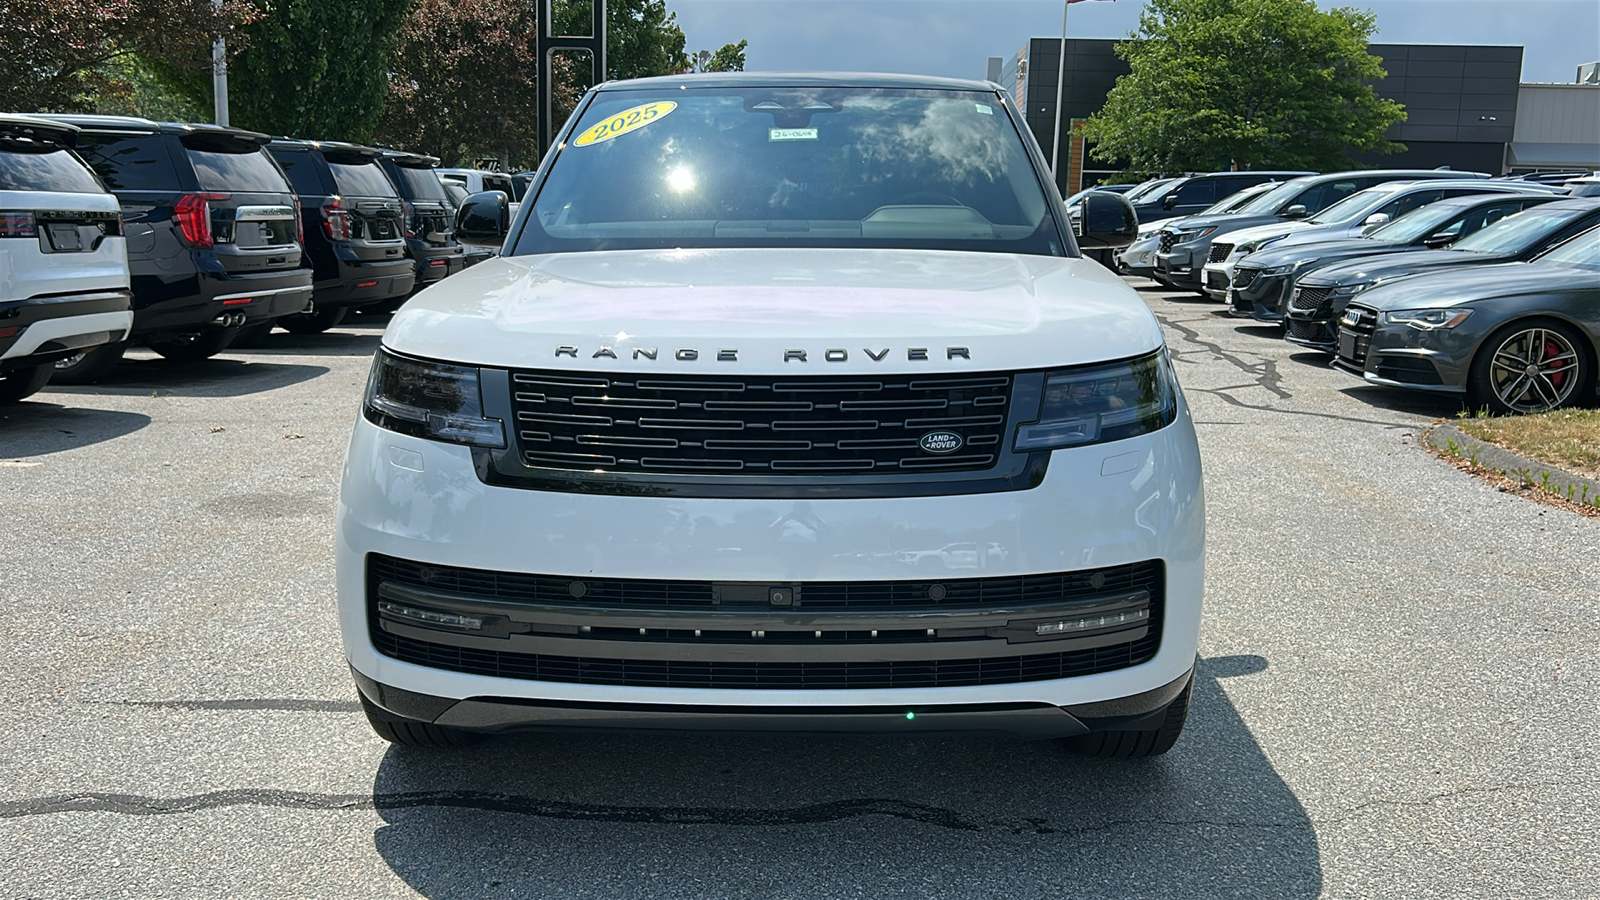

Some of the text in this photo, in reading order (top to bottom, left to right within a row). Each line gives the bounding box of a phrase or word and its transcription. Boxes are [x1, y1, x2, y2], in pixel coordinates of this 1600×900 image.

[594, 104, 659, 141] 2025
[554, 345, 971, 362] RANGE ROVER
[930, 441, 956, 449] ROVER
